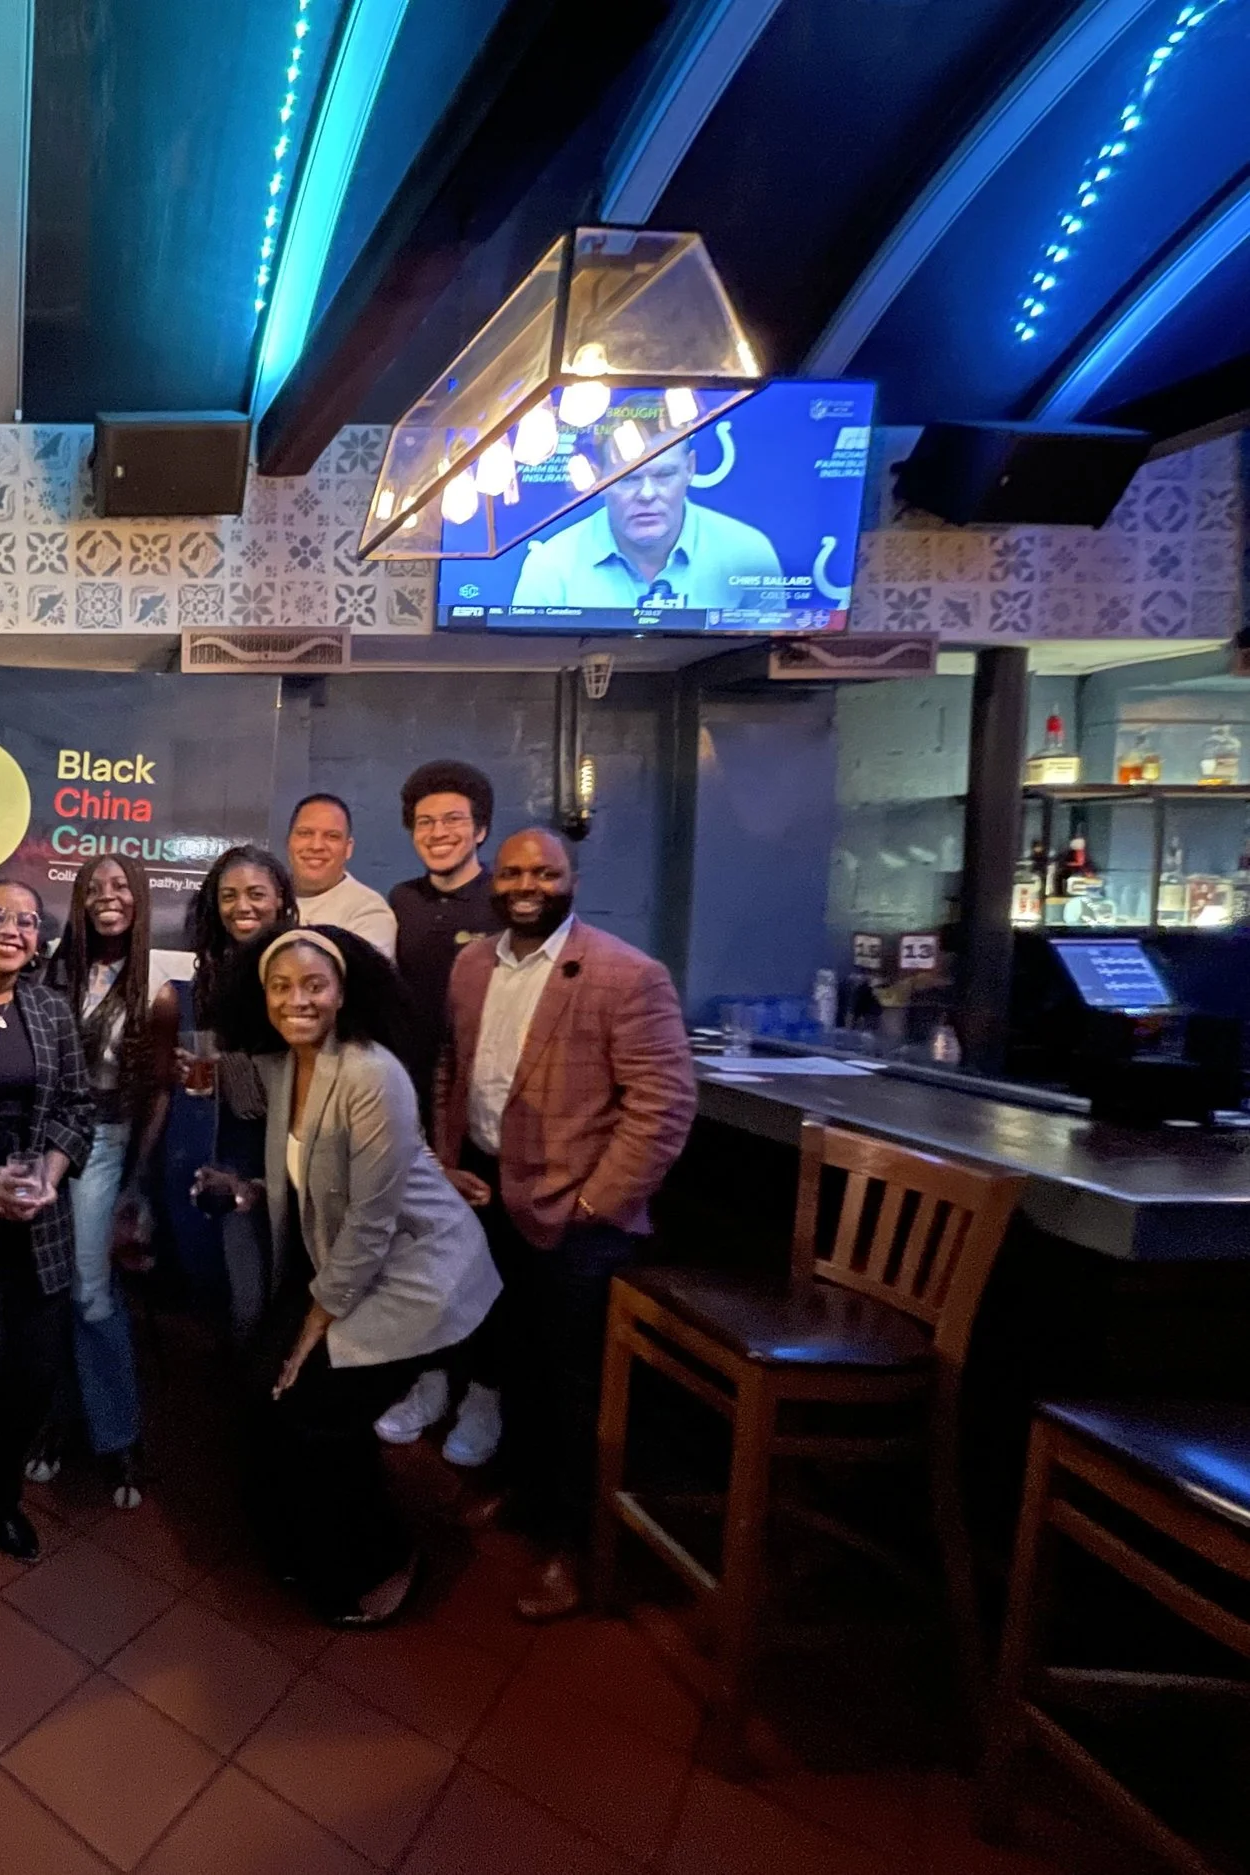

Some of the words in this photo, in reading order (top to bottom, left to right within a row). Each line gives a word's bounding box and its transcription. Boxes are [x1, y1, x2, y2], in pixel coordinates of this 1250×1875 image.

[521, 473, 570, 482] INSURAN
[728, 576, 760, 586] CHRIS
[763, 576, 812, 586] BALLARD
[57, 749, 157, 785] Black
[54, 786, 152, 823] China
[51, 825, 182, 863] Caucus
